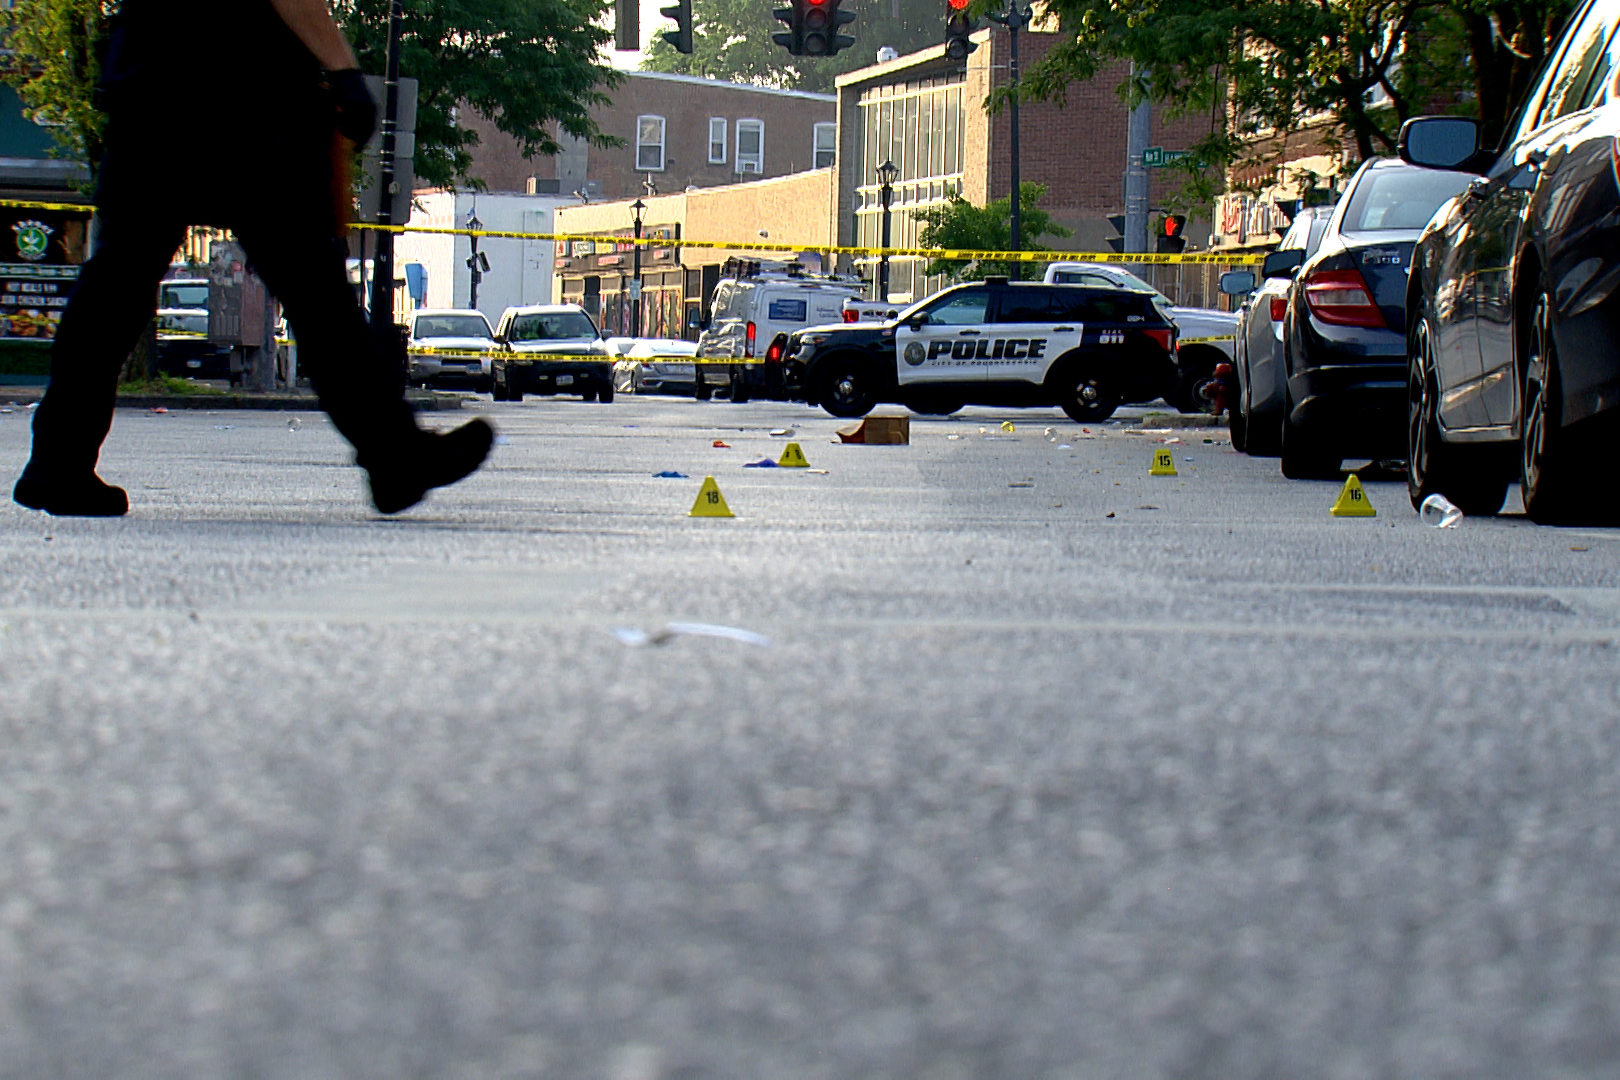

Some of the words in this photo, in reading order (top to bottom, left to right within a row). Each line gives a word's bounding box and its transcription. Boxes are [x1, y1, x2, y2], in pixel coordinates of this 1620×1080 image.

[927, 339, 1047, 360] POLICE
[1158, 455, 1170, 466] 15
[706, 491, 719, 504] 18
[1350, 488, 1362, 500] 16
